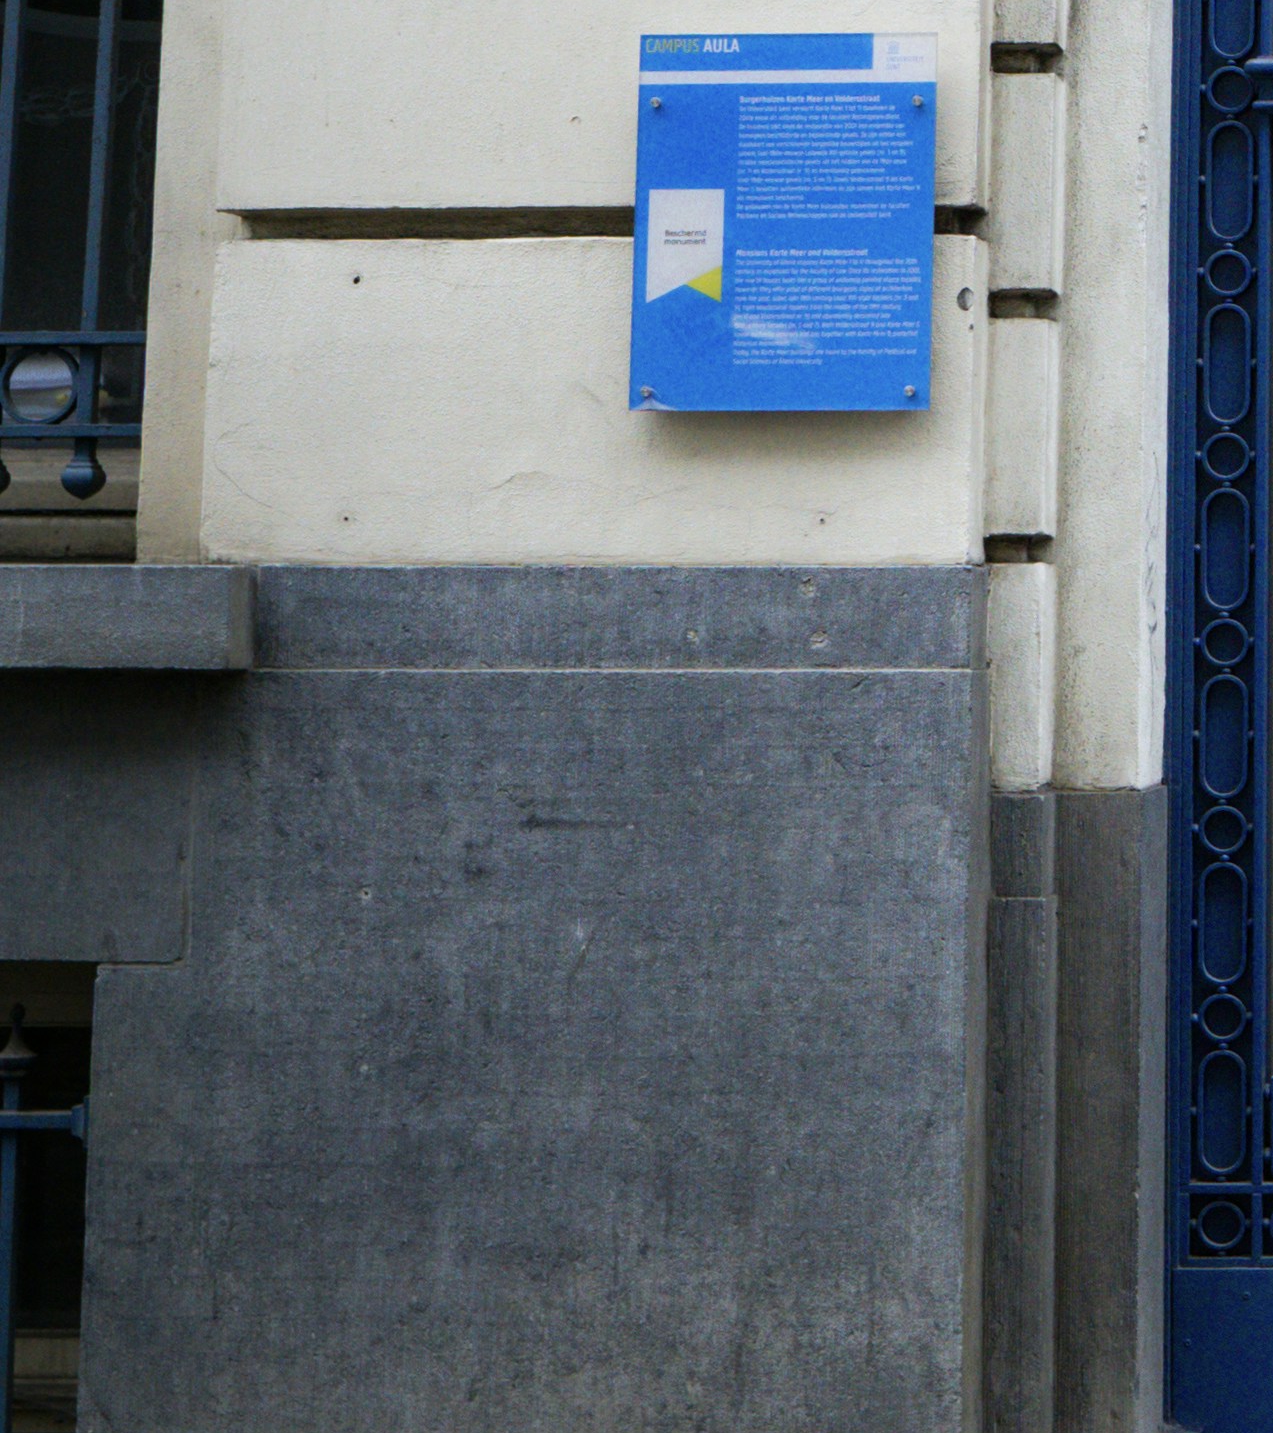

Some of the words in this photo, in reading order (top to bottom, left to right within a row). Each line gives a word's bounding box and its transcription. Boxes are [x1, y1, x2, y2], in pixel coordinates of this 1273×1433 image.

[646, 38, 699, 53] CAMPUS
[703, 38, 740, 53] AULA
[665, 229, 707, 237] Beschermd
